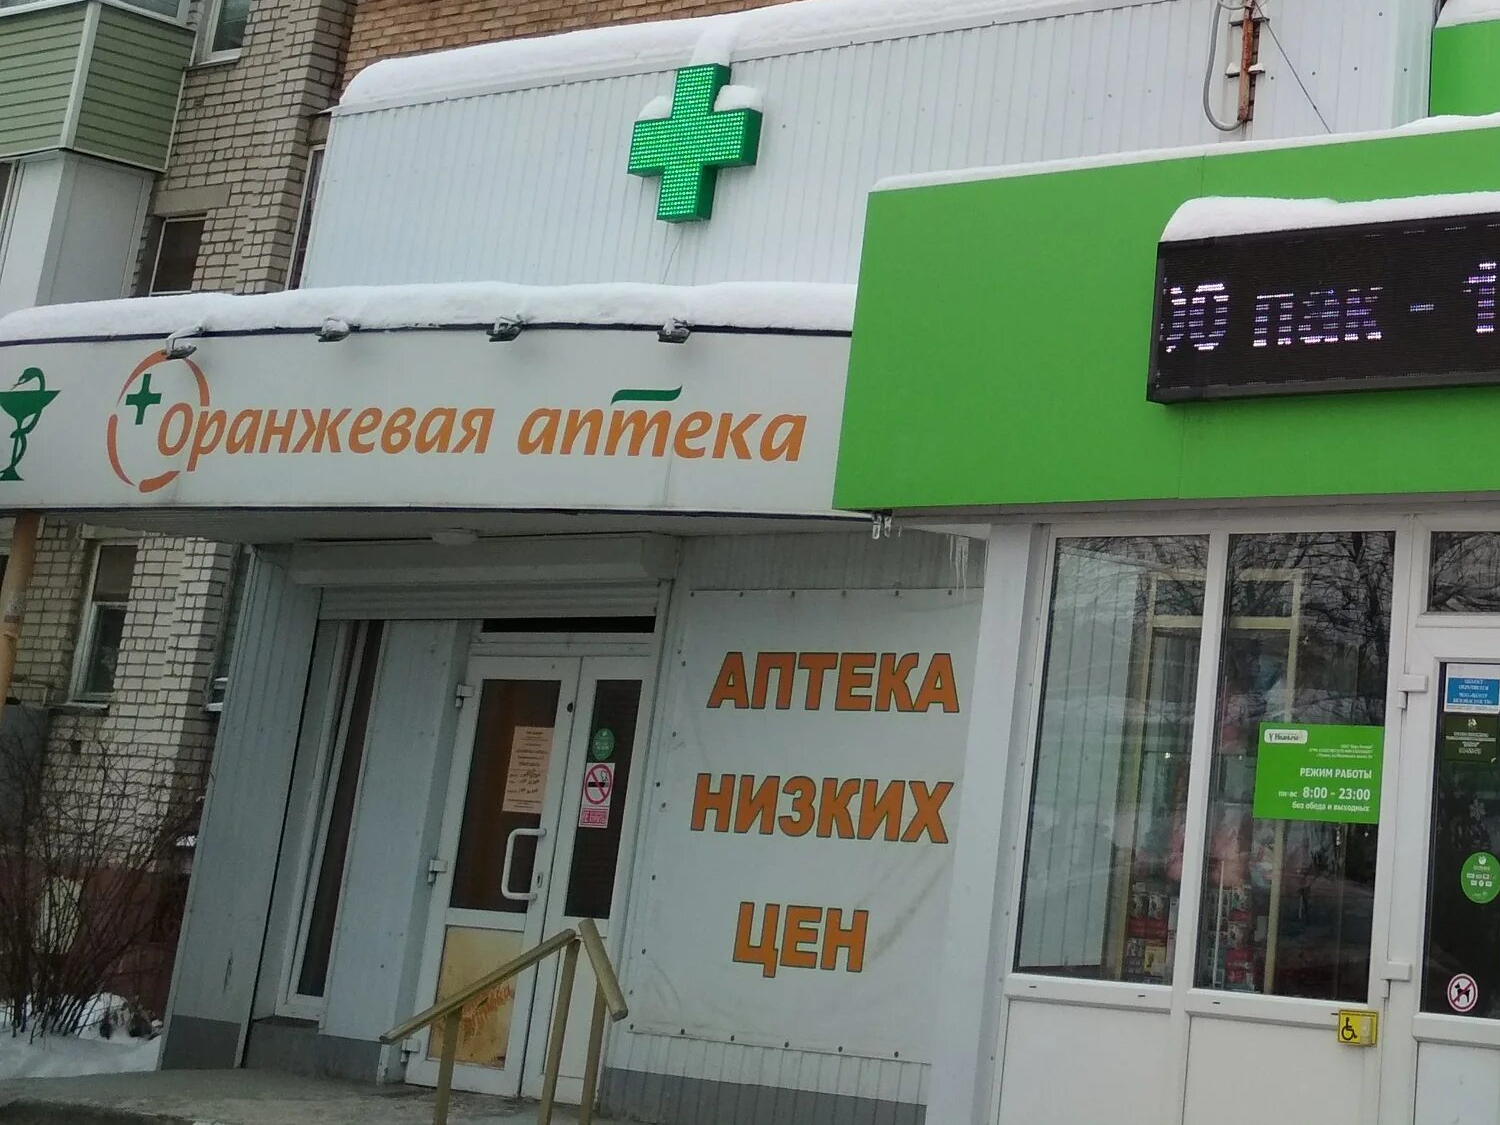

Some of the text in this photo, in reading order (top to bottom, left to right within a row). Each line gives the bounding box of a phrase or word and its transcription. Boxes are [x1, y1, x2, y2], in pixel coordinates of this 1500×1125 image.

[1252, 285, 1385, 349] пак
[157, 401, 808, 473] Оранжевая аптека
[706, 651, 960, 713] АПТЕКА
[1299, 767, 1372, 780] РЕЖИМ РАБОТЫ
[1302, 786, 1328, 799] 8:00
[1338, 787, 1371, 801] 23:00
[690, 773, 955, 844] НИЗКИХ
[732, 901, 869, 978] ЦЕН
